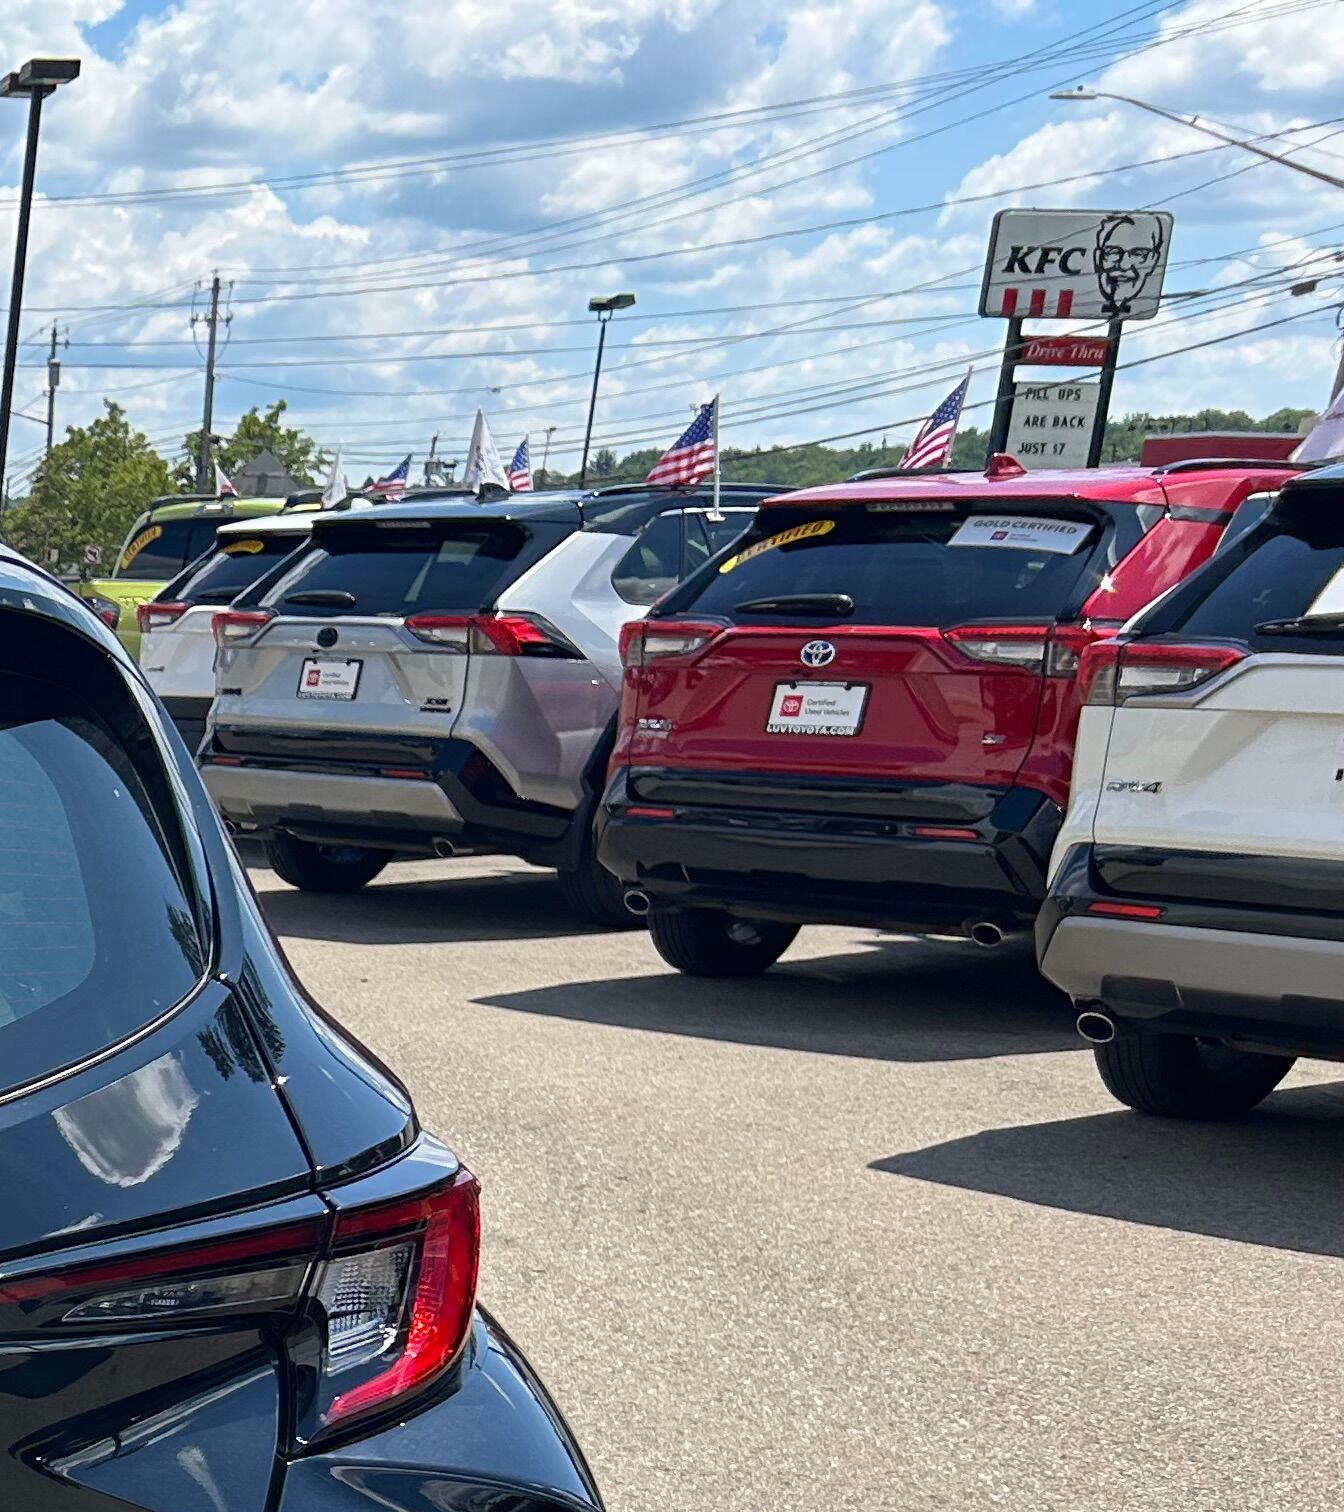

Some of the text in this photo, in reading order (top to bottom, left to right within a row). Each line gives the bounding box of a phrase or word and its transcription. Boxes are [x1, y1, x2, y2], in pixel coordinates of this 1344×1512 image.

[1001, 246, 1087, 276] KFC
[1026, 342, 1104, 360] Drive Thru
[1057, 387, 1081, 401] UPS
[1023, 415, 1086, 428] ARE BACK
[1017, 442, 1048, 455] JUST
[973, 519, 1078, 535] GOLD CERTIFIED
